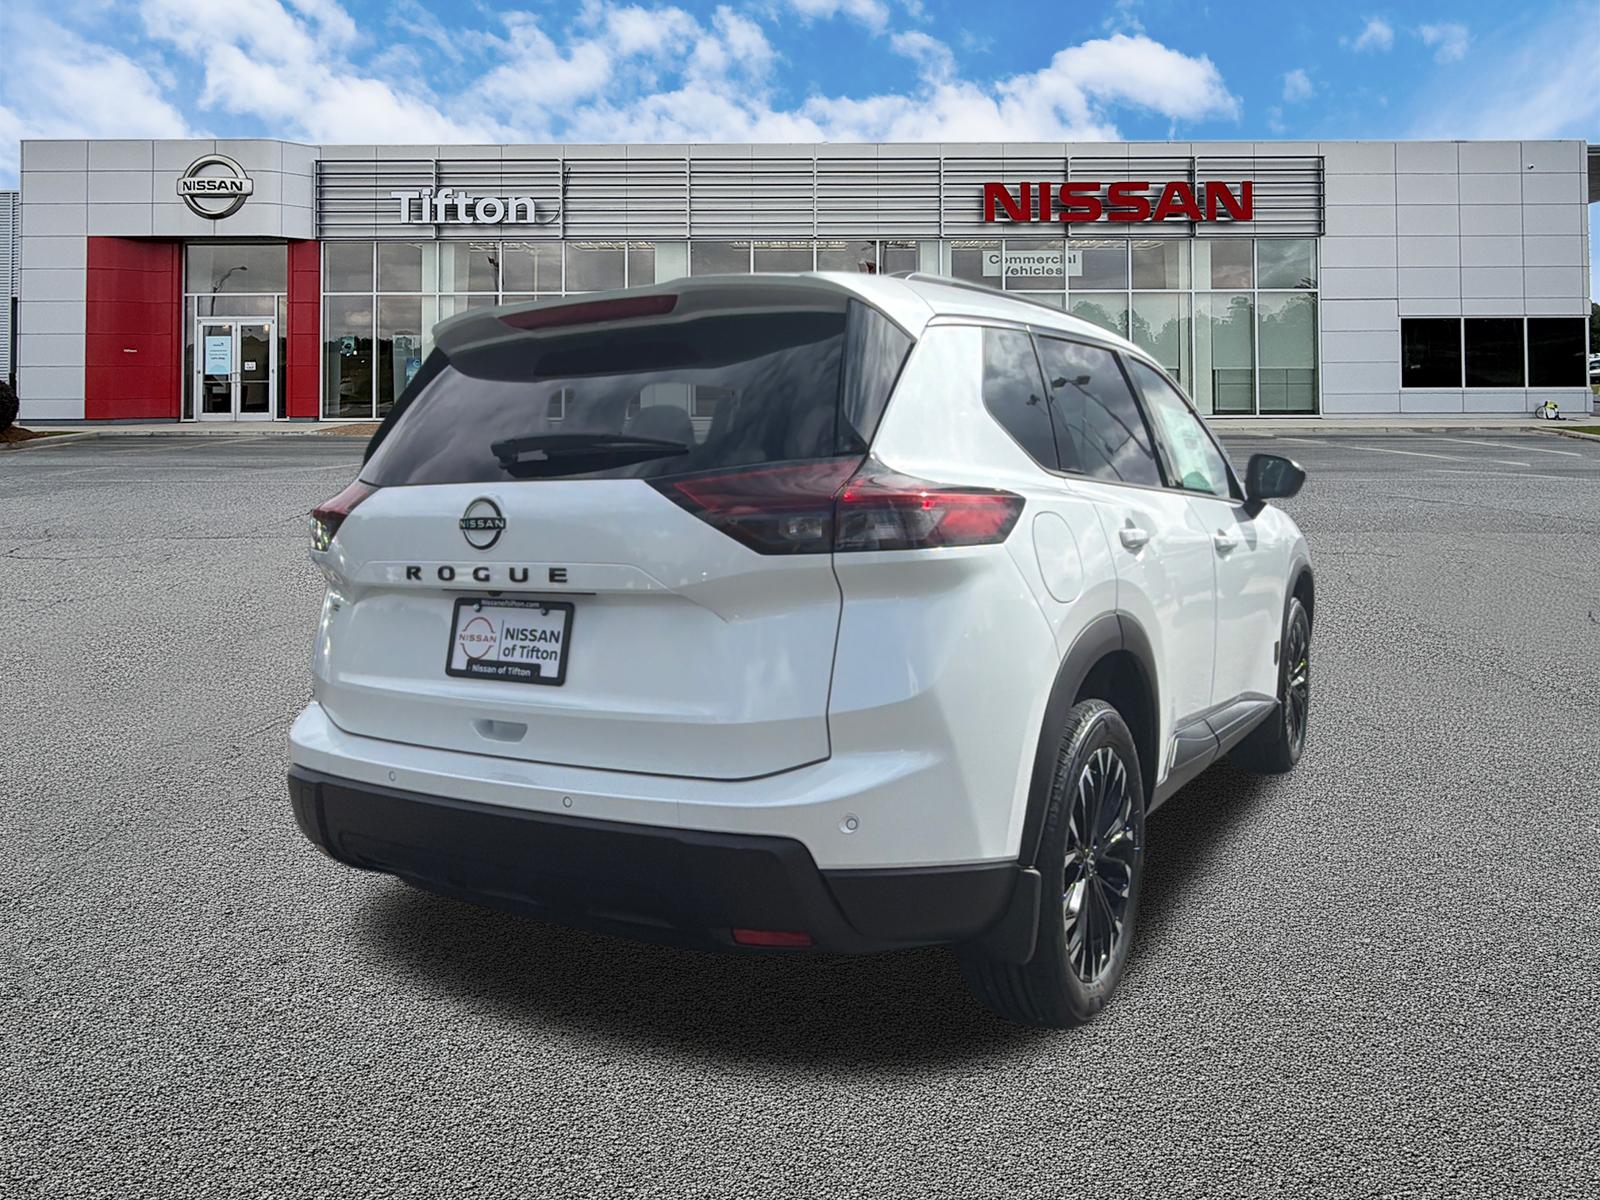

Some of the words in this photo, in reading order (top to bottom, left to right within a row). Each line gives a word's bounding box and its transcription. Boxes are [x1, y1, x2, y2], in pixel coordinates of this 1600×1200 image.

[183, 181, 242, 191] NISSAN
[391, 188, 536, 224] Tifton
[984, 181, 1253, 222] NISSAN
[460, 519, 504, 529] NISSAN
[406, 565, 568, 583] ROGUE
[459, 633, 496, 643] NISSAN
[504, 627, 561, 644] NISSAN
[502, 644, 517, 658] of
[519, 645, 558, 661] Tifton
[472, 664, 497, 674] Nissan
[507, 668, 531, 677] Tifton
